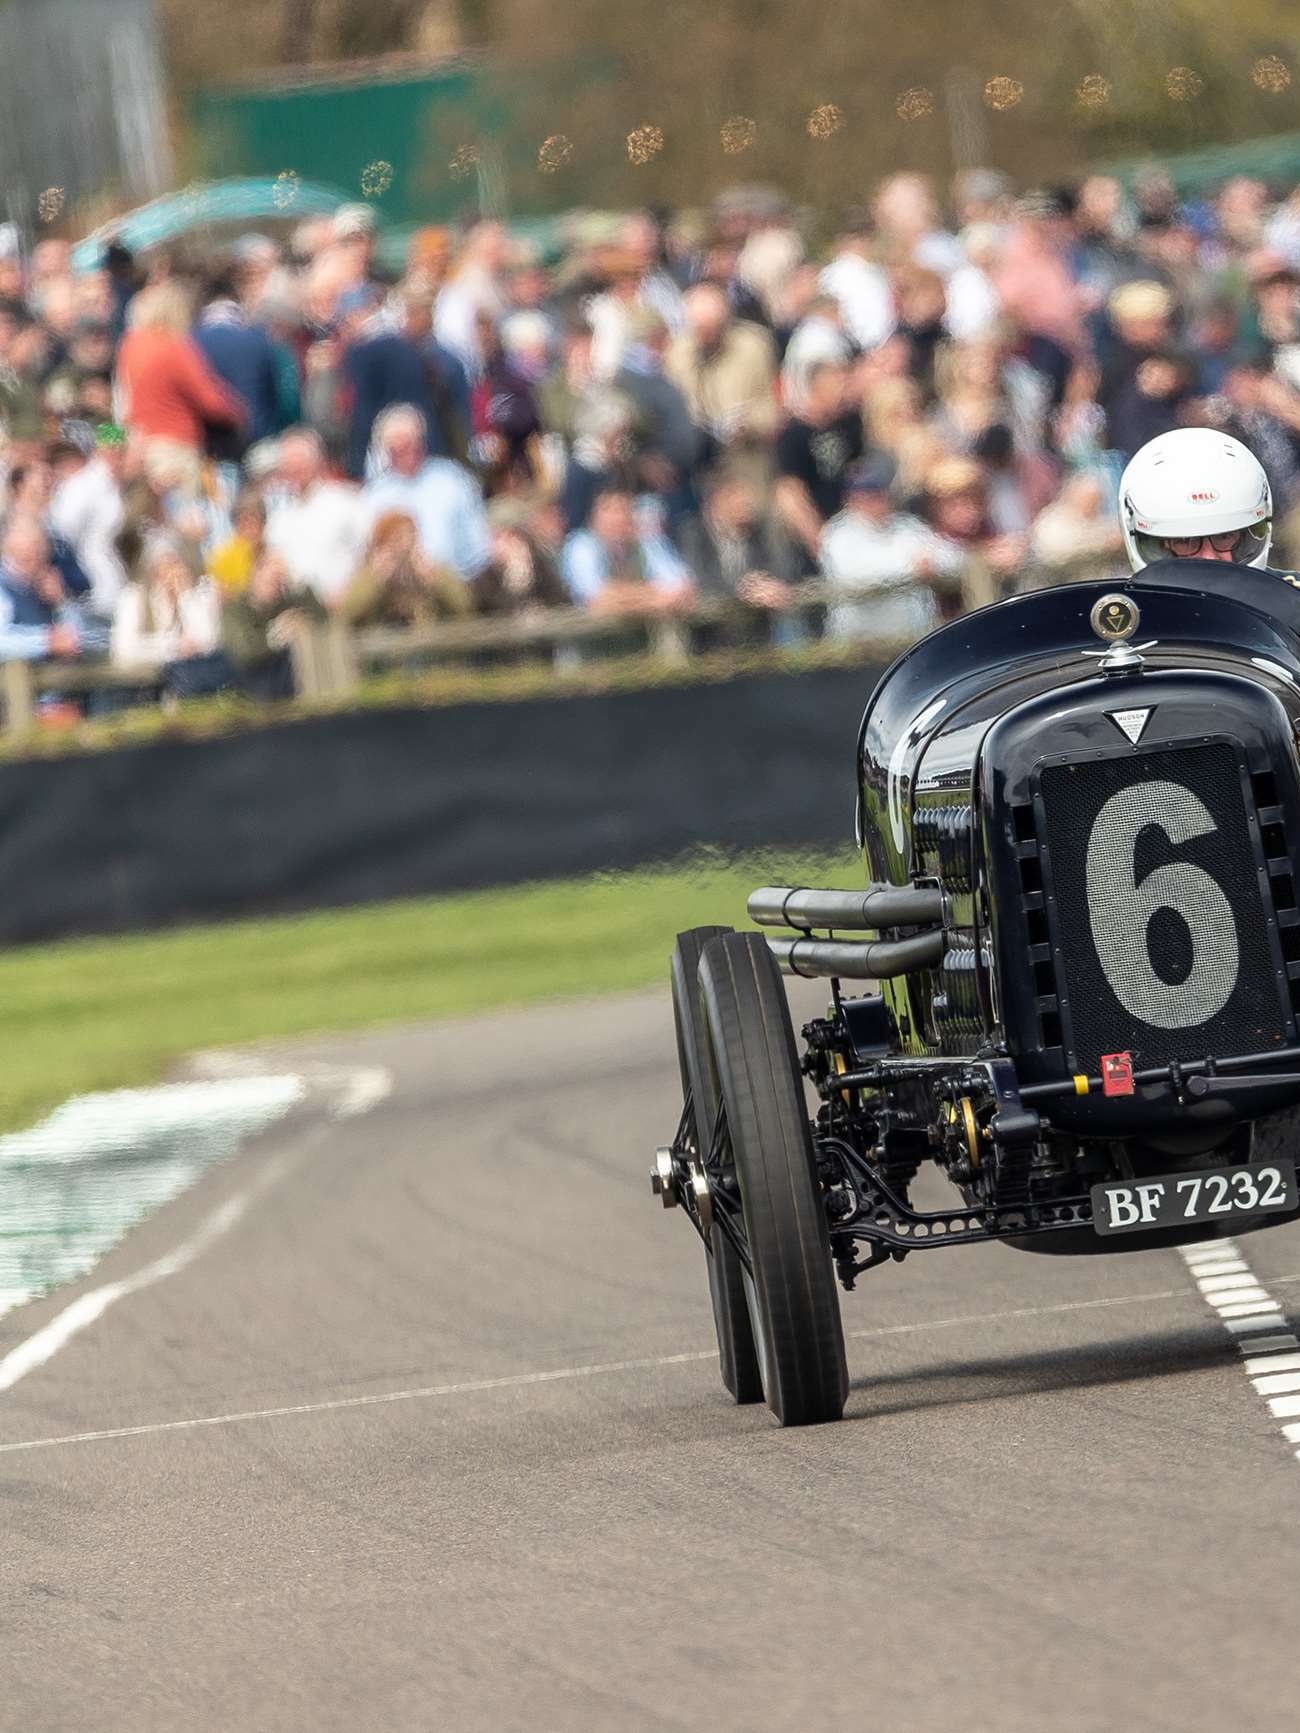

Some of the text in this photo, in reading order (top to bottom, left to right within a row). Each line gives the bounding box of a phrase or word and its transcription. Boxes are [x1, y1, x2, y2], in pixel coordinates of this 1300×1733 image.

[1191, 492, 1216, 501] BELL
[1086, 780, 1240, 1029] 6
[1104, 1167, 1287, 1228] BF 7232
